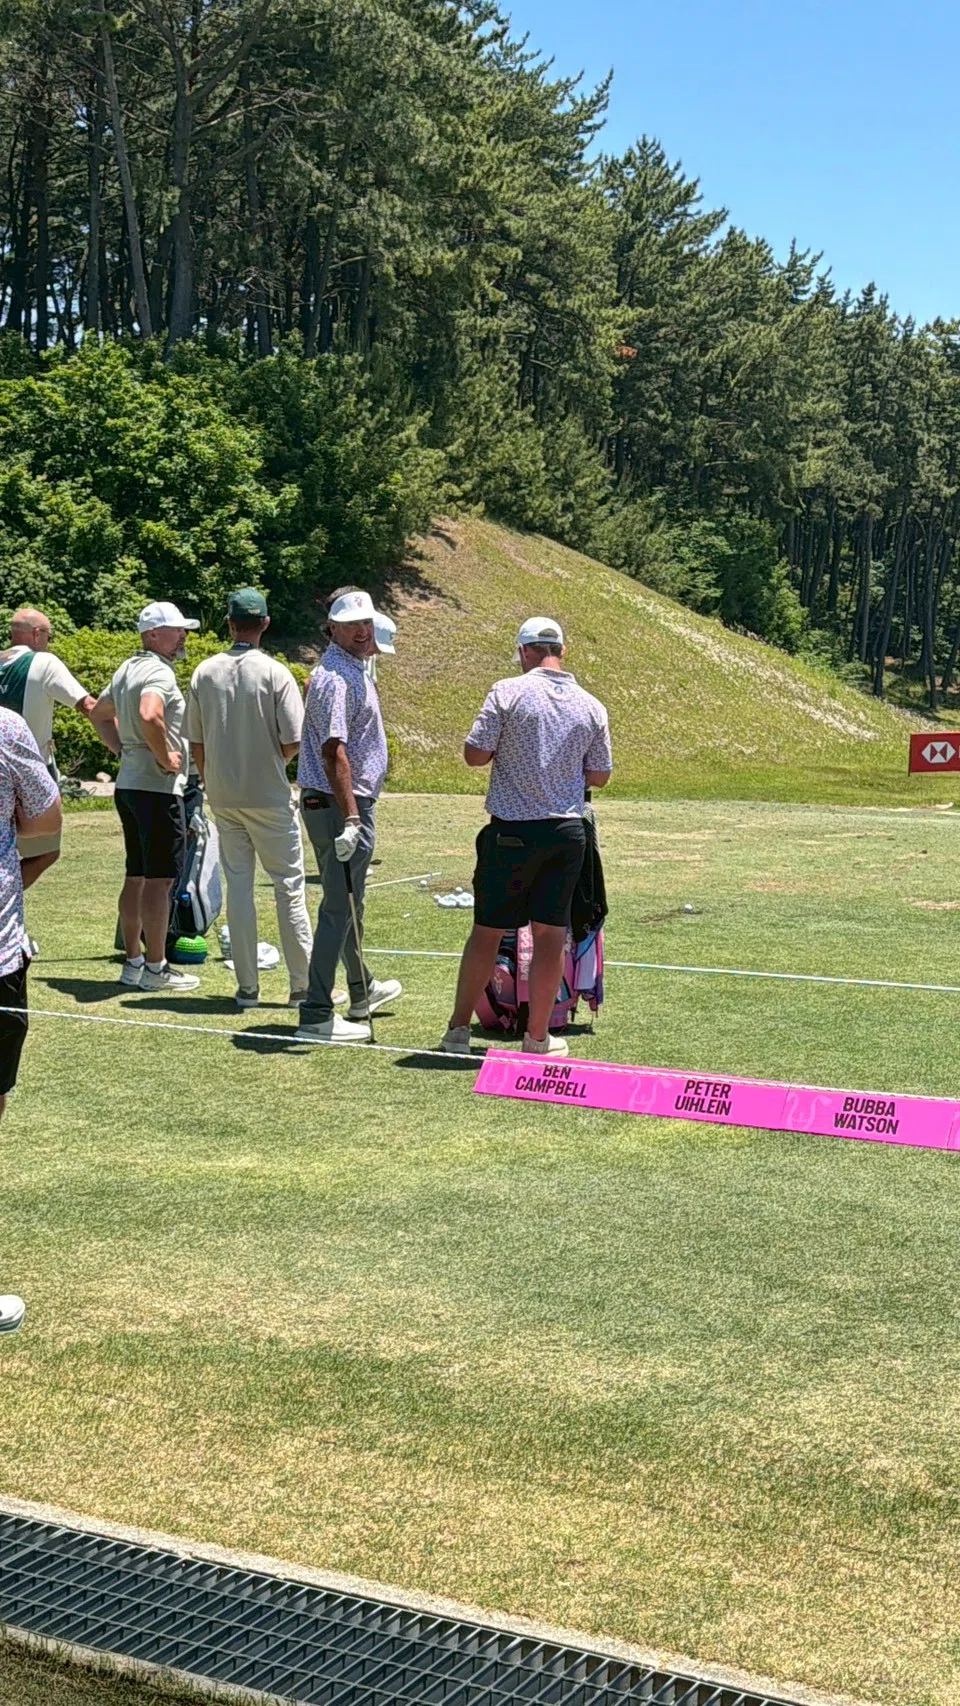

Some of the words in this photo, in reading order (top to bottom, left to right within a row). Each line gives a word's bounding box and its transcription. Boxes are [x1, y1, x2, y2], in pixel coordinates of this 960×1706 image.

[542, 1064, 572, 1080] BEN
[515, 1076, 588, 1099] CAMPBELL
[683, 1079, 732, 1099] PETER
[674, 1095, 732, 1116] UIHLEIN
[842, 1096, 896, 1118] BUBBA
[834, 1112, 899, 1135] WATSON
